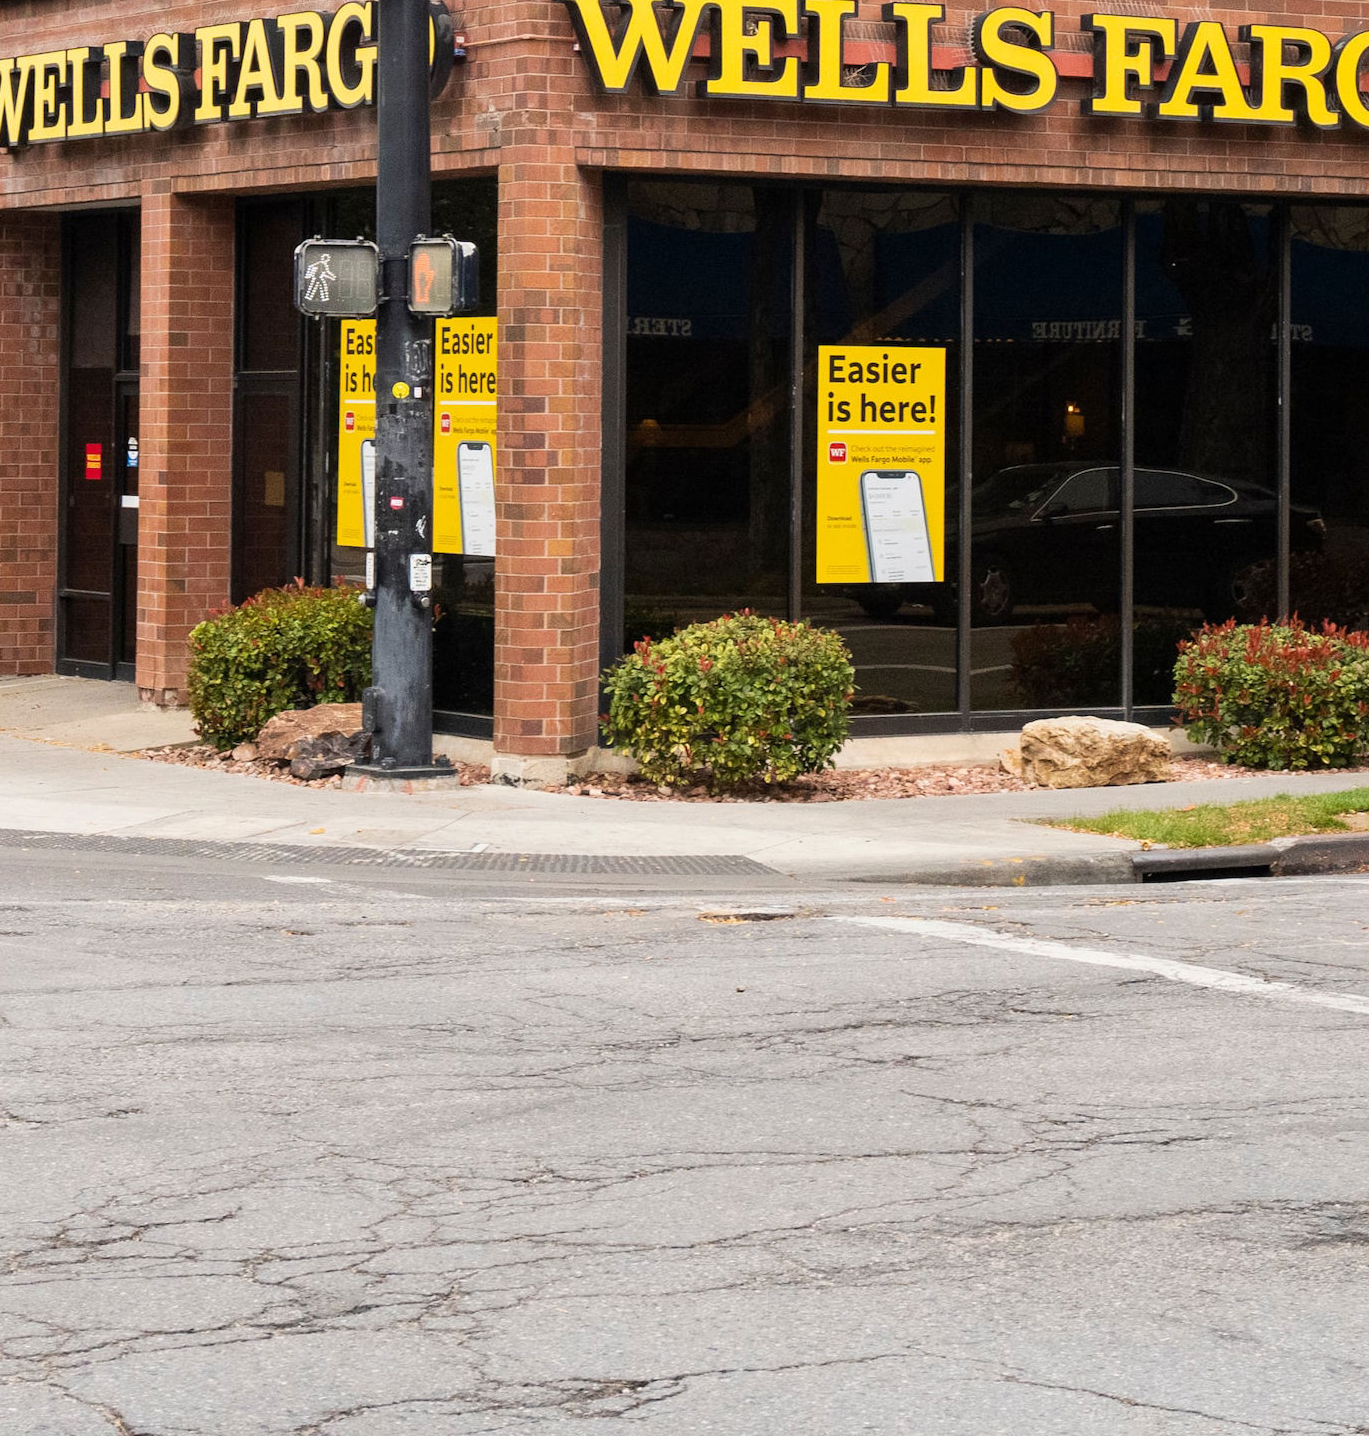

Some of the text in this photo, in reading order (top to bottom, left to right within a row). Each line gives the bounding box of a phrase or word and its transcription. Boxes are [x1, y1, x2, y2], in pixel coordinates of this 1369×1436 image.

[194, 1, 436, 122] FARG
[441, 324, 494, 355] Easier
[345, 364, 357, 393] is
[441, 364, 496, 394] is here
[829, 353, 921, 384] Easier
[828, 391, 936, 423] is here!
[830, 448, 846, 457] WF
[851, 444, 871, 453] Check
[873, 445, 884, 453] out
[885, 444, 897, 453] the
[871, 456, 890, 465] Fargo
